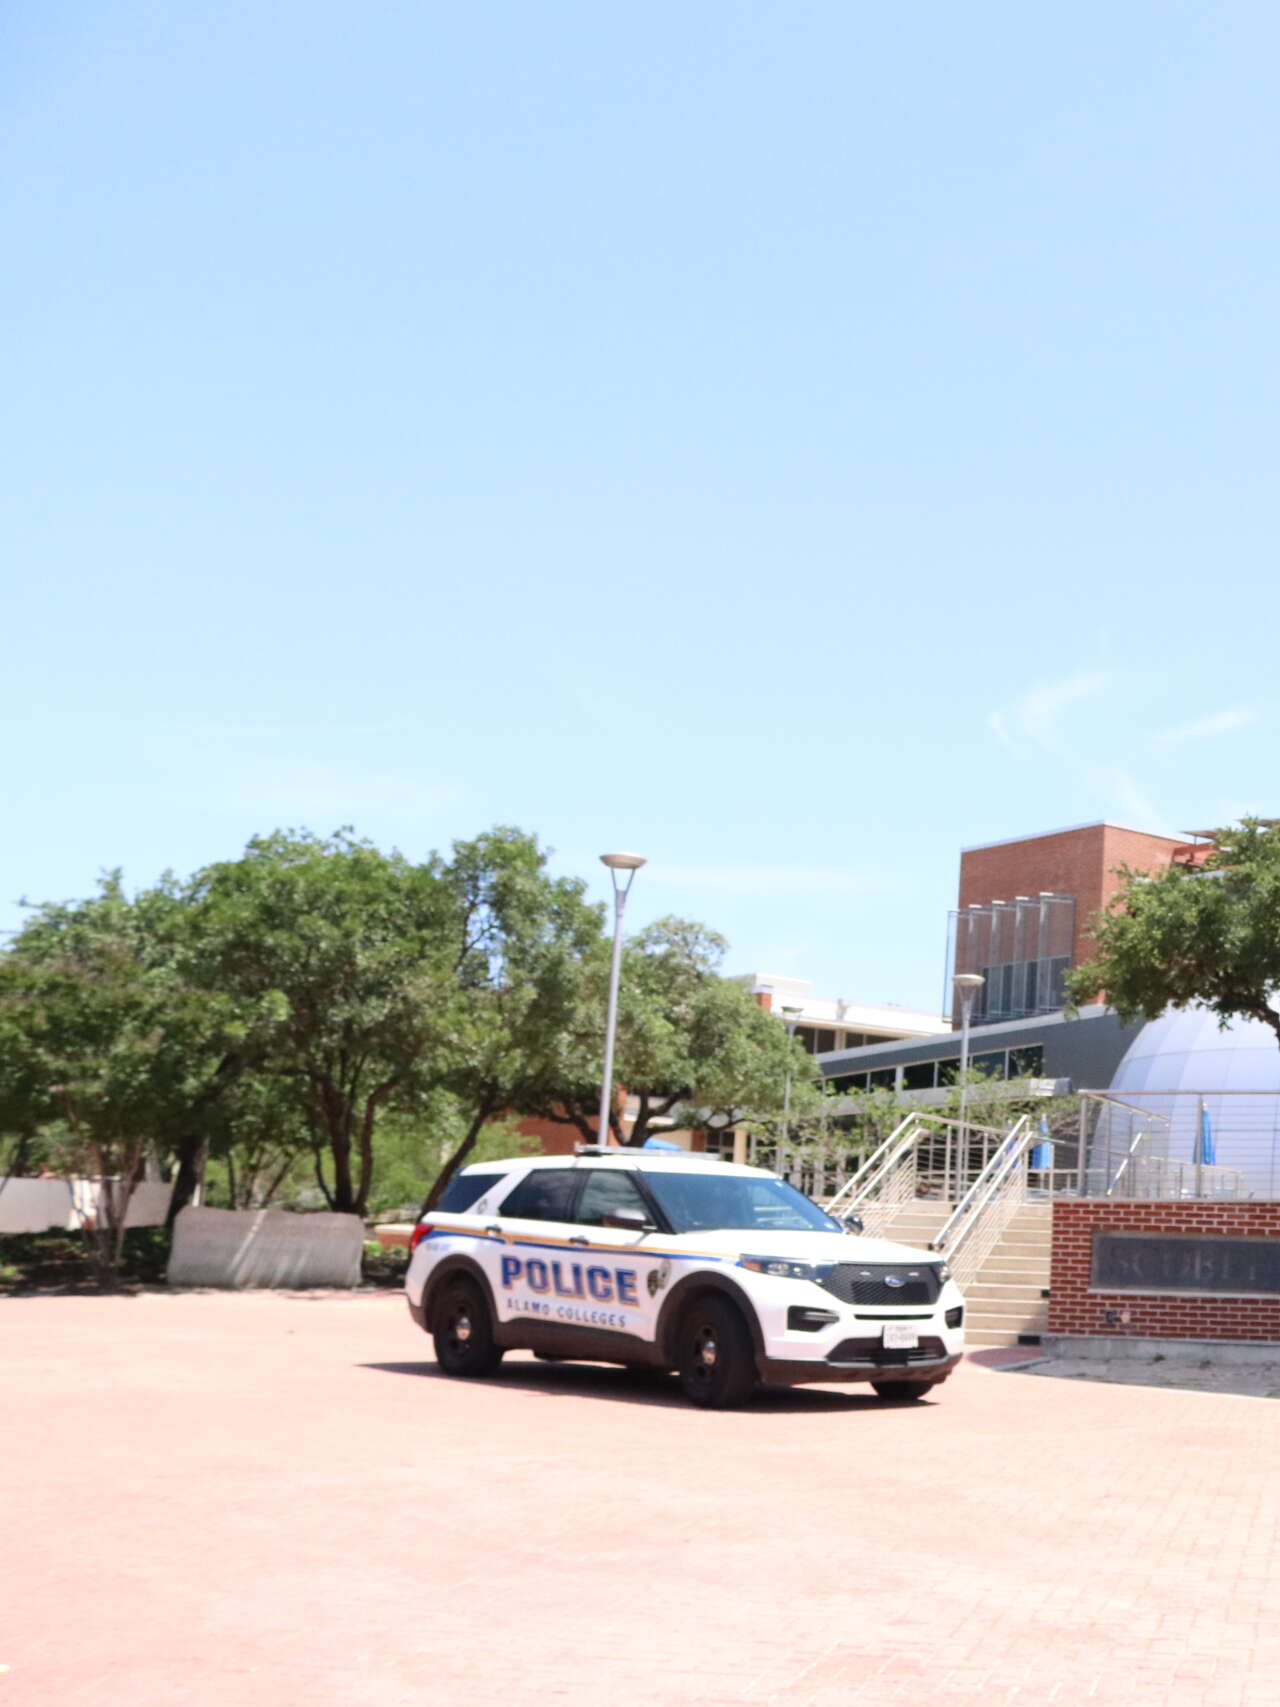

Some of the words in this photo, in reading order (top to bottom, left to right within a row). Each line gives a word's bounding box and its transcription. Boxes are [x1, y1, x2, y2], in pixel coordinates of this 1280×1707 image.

[501, 1254, 639, 1308] POLICE
[507, 1298, 550, 1316] ALAMO
[557, 1305, 627, 1329] COLLEGES
